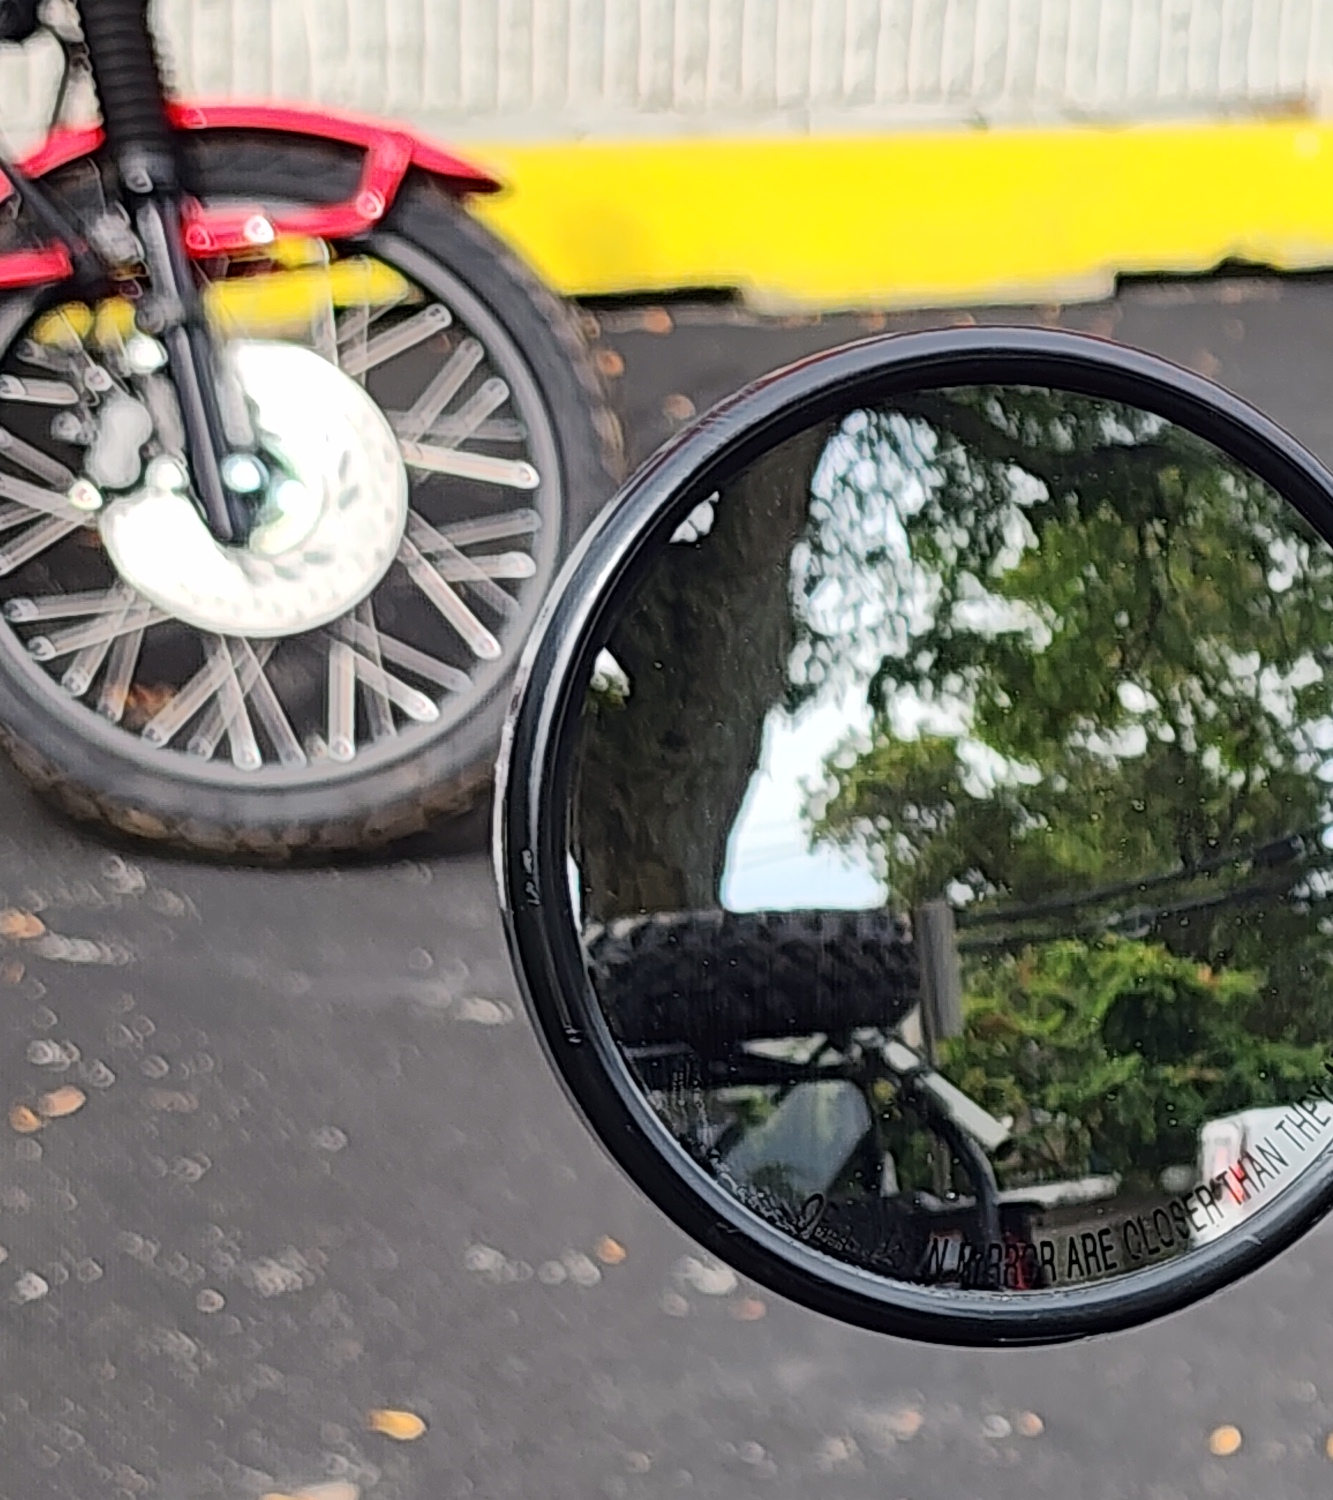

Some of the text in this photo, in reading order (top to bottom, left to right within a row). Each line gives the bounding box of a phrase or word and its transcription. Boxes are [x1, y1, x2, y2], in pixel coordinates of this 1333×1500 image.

[1067, 1229, 1117, 1280] ARE
[1123, 1185, 1224, 1260] CLOSER
[1216, 1137, 1290, 1206] THAN
